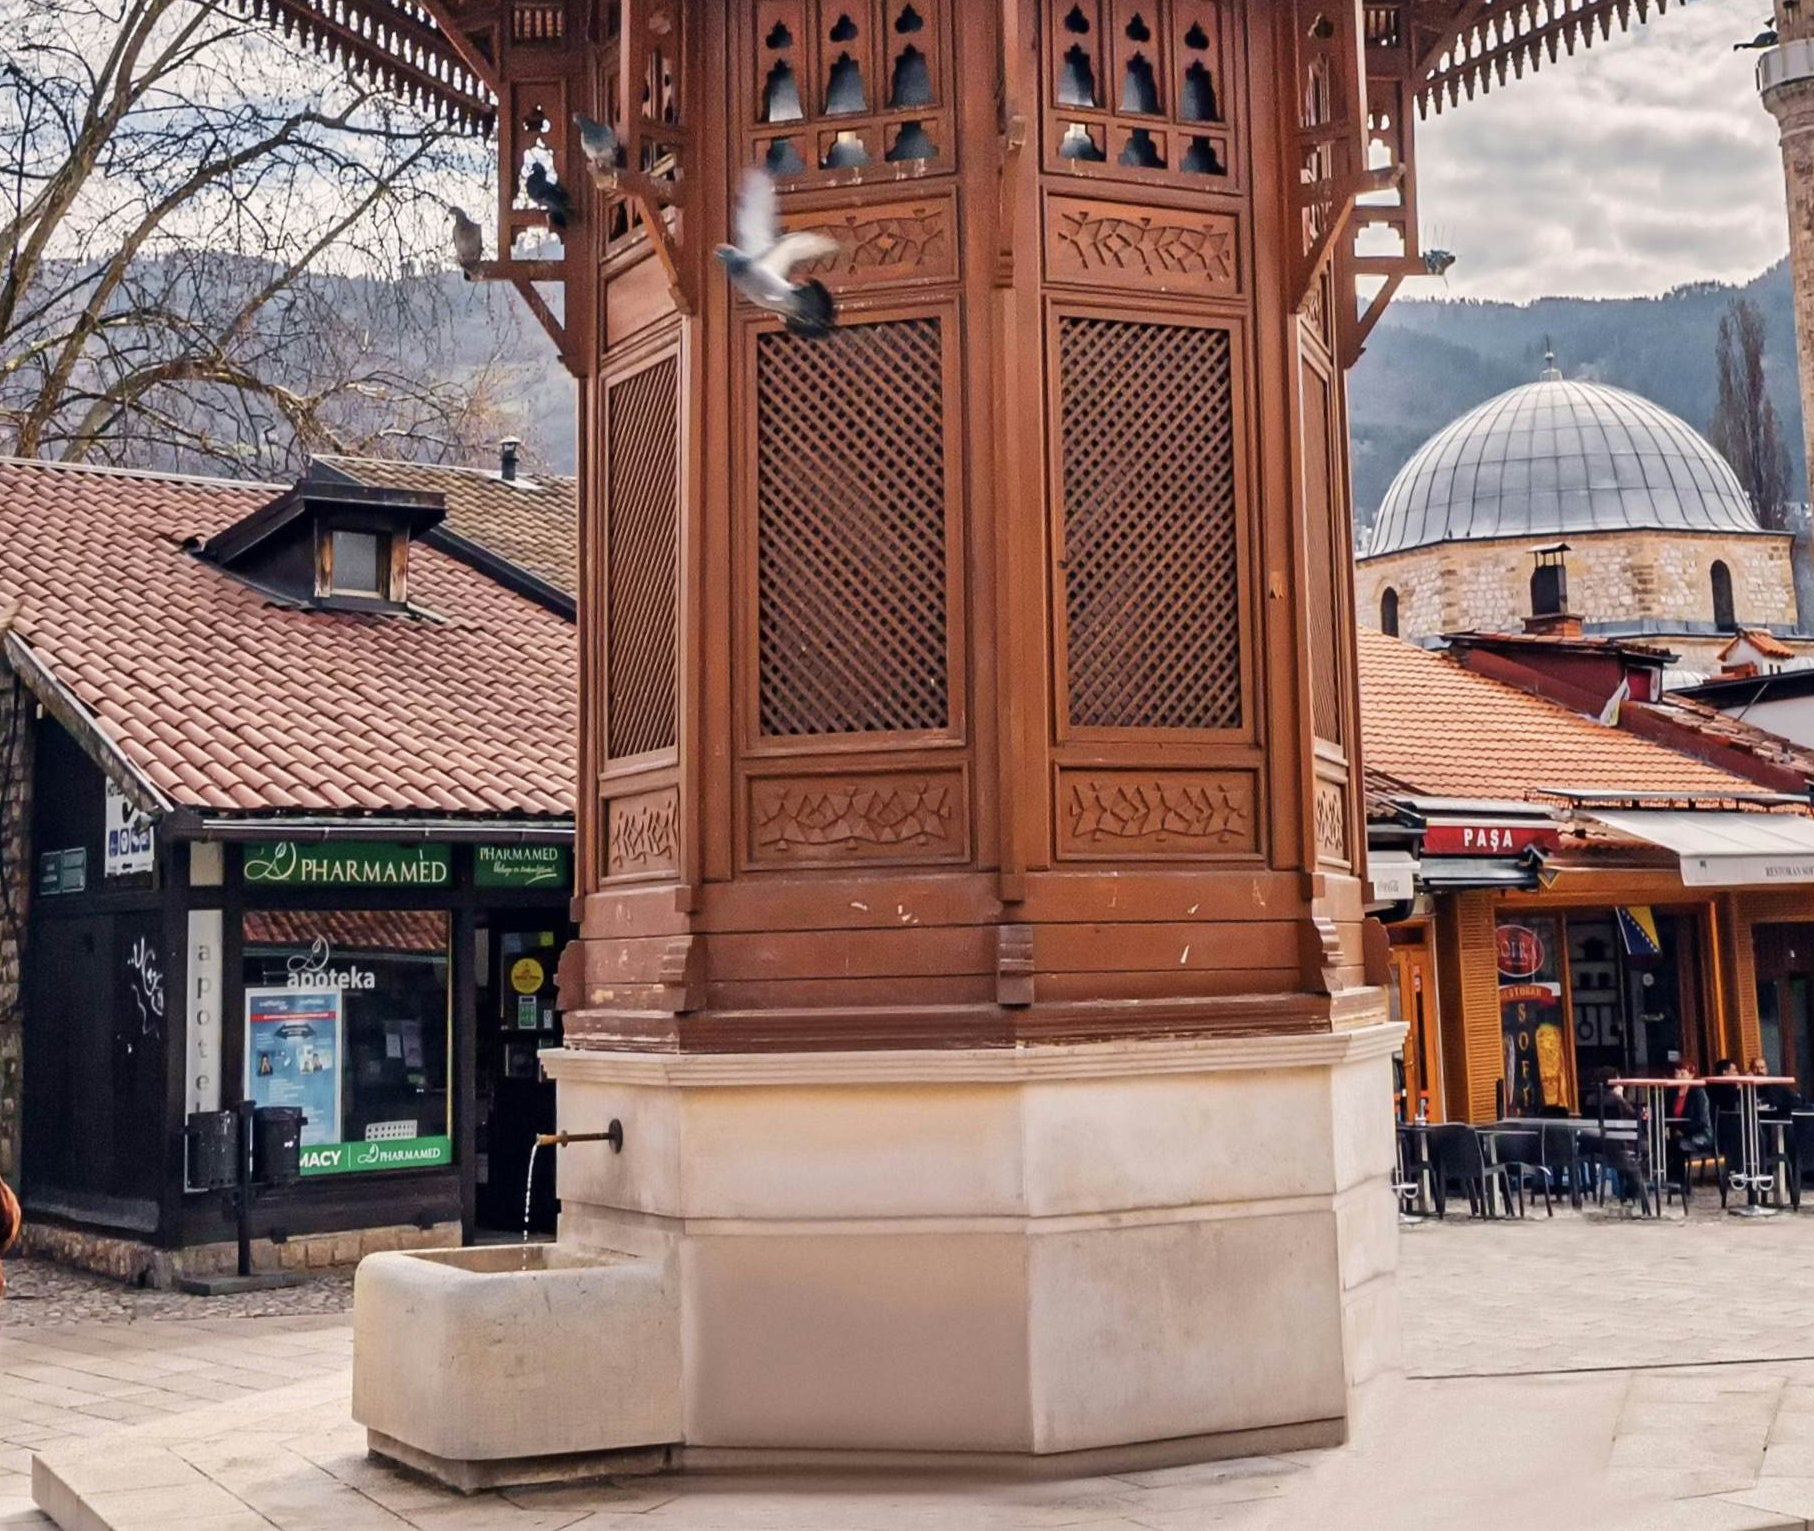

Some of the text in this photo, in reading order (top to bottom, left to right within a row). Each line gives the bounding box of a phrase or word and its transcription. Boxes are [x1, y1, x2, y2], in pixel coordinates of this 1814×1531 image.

[1463, 828, 1513, 852] PAŞA
[479, 847, 558, 860] PHARMAMED
[286, 965, 375, 989] apoteka
[379, 1147, 441, 1163] PHARMAMED
